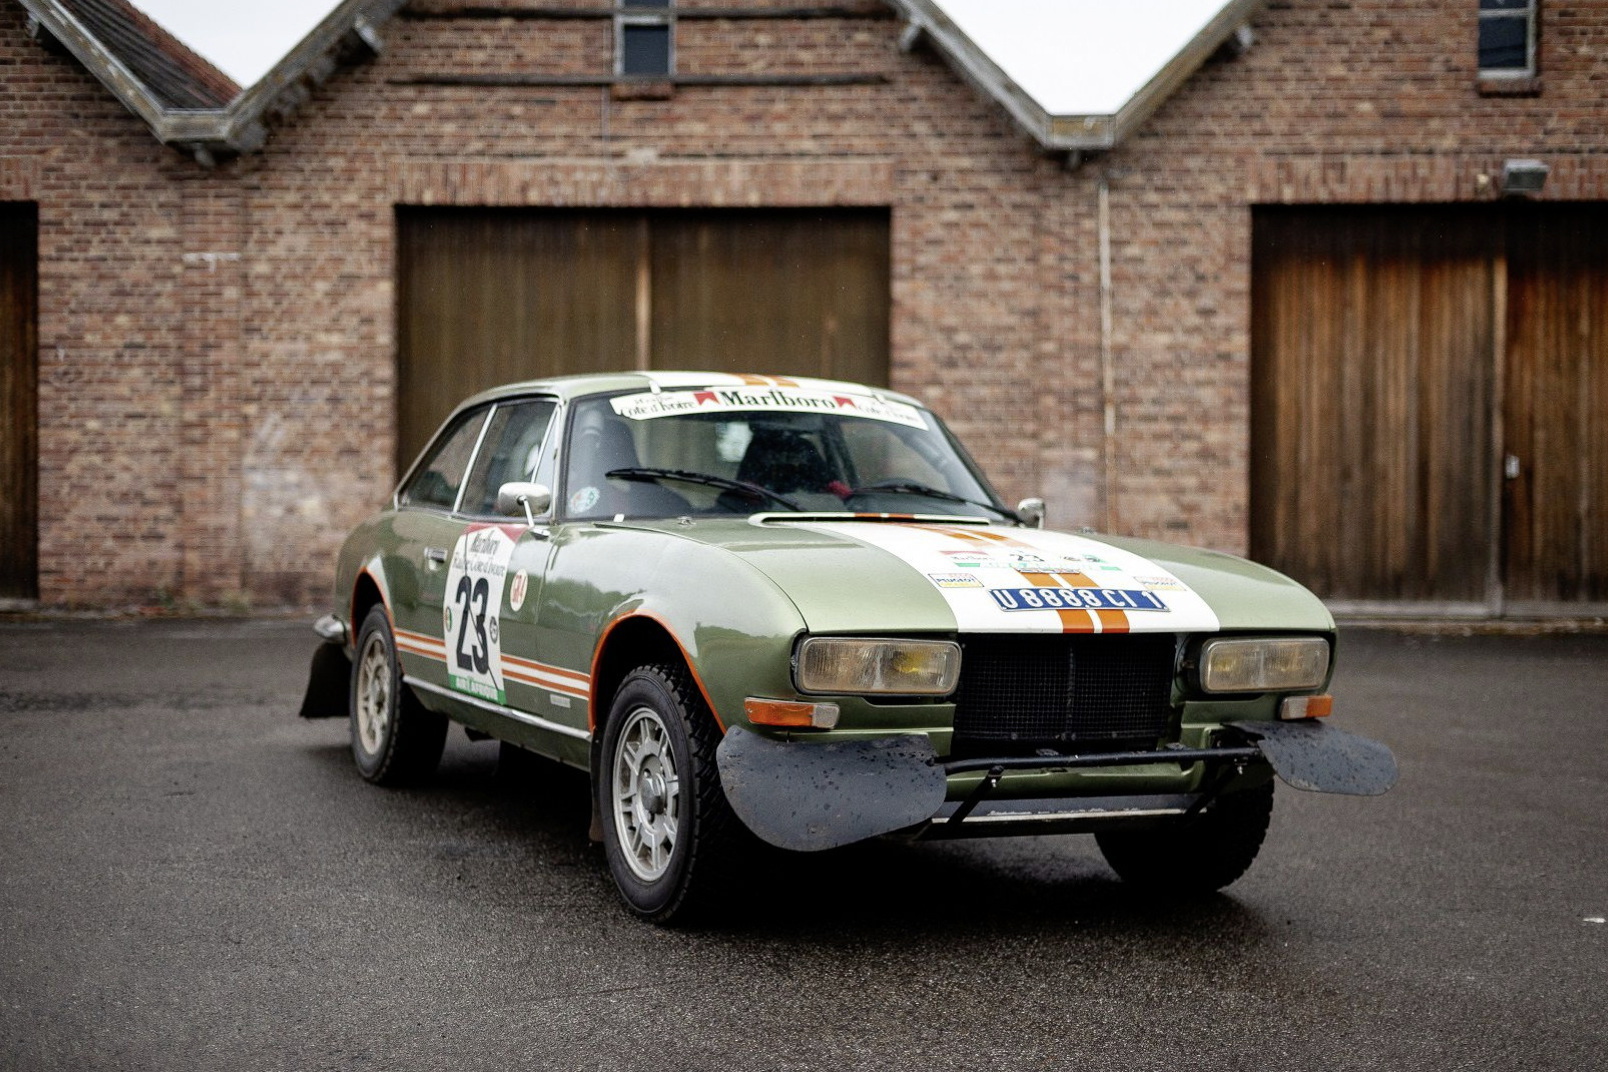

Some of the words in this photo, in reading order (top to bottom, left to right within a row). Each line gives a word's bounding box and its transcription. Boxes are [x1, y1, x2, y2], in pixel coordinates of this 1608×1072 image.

[719, 390, 836, 409] Marlboro
[1019, 588, 1102, 607] 8888
[455, 575, 490, 675] 23
